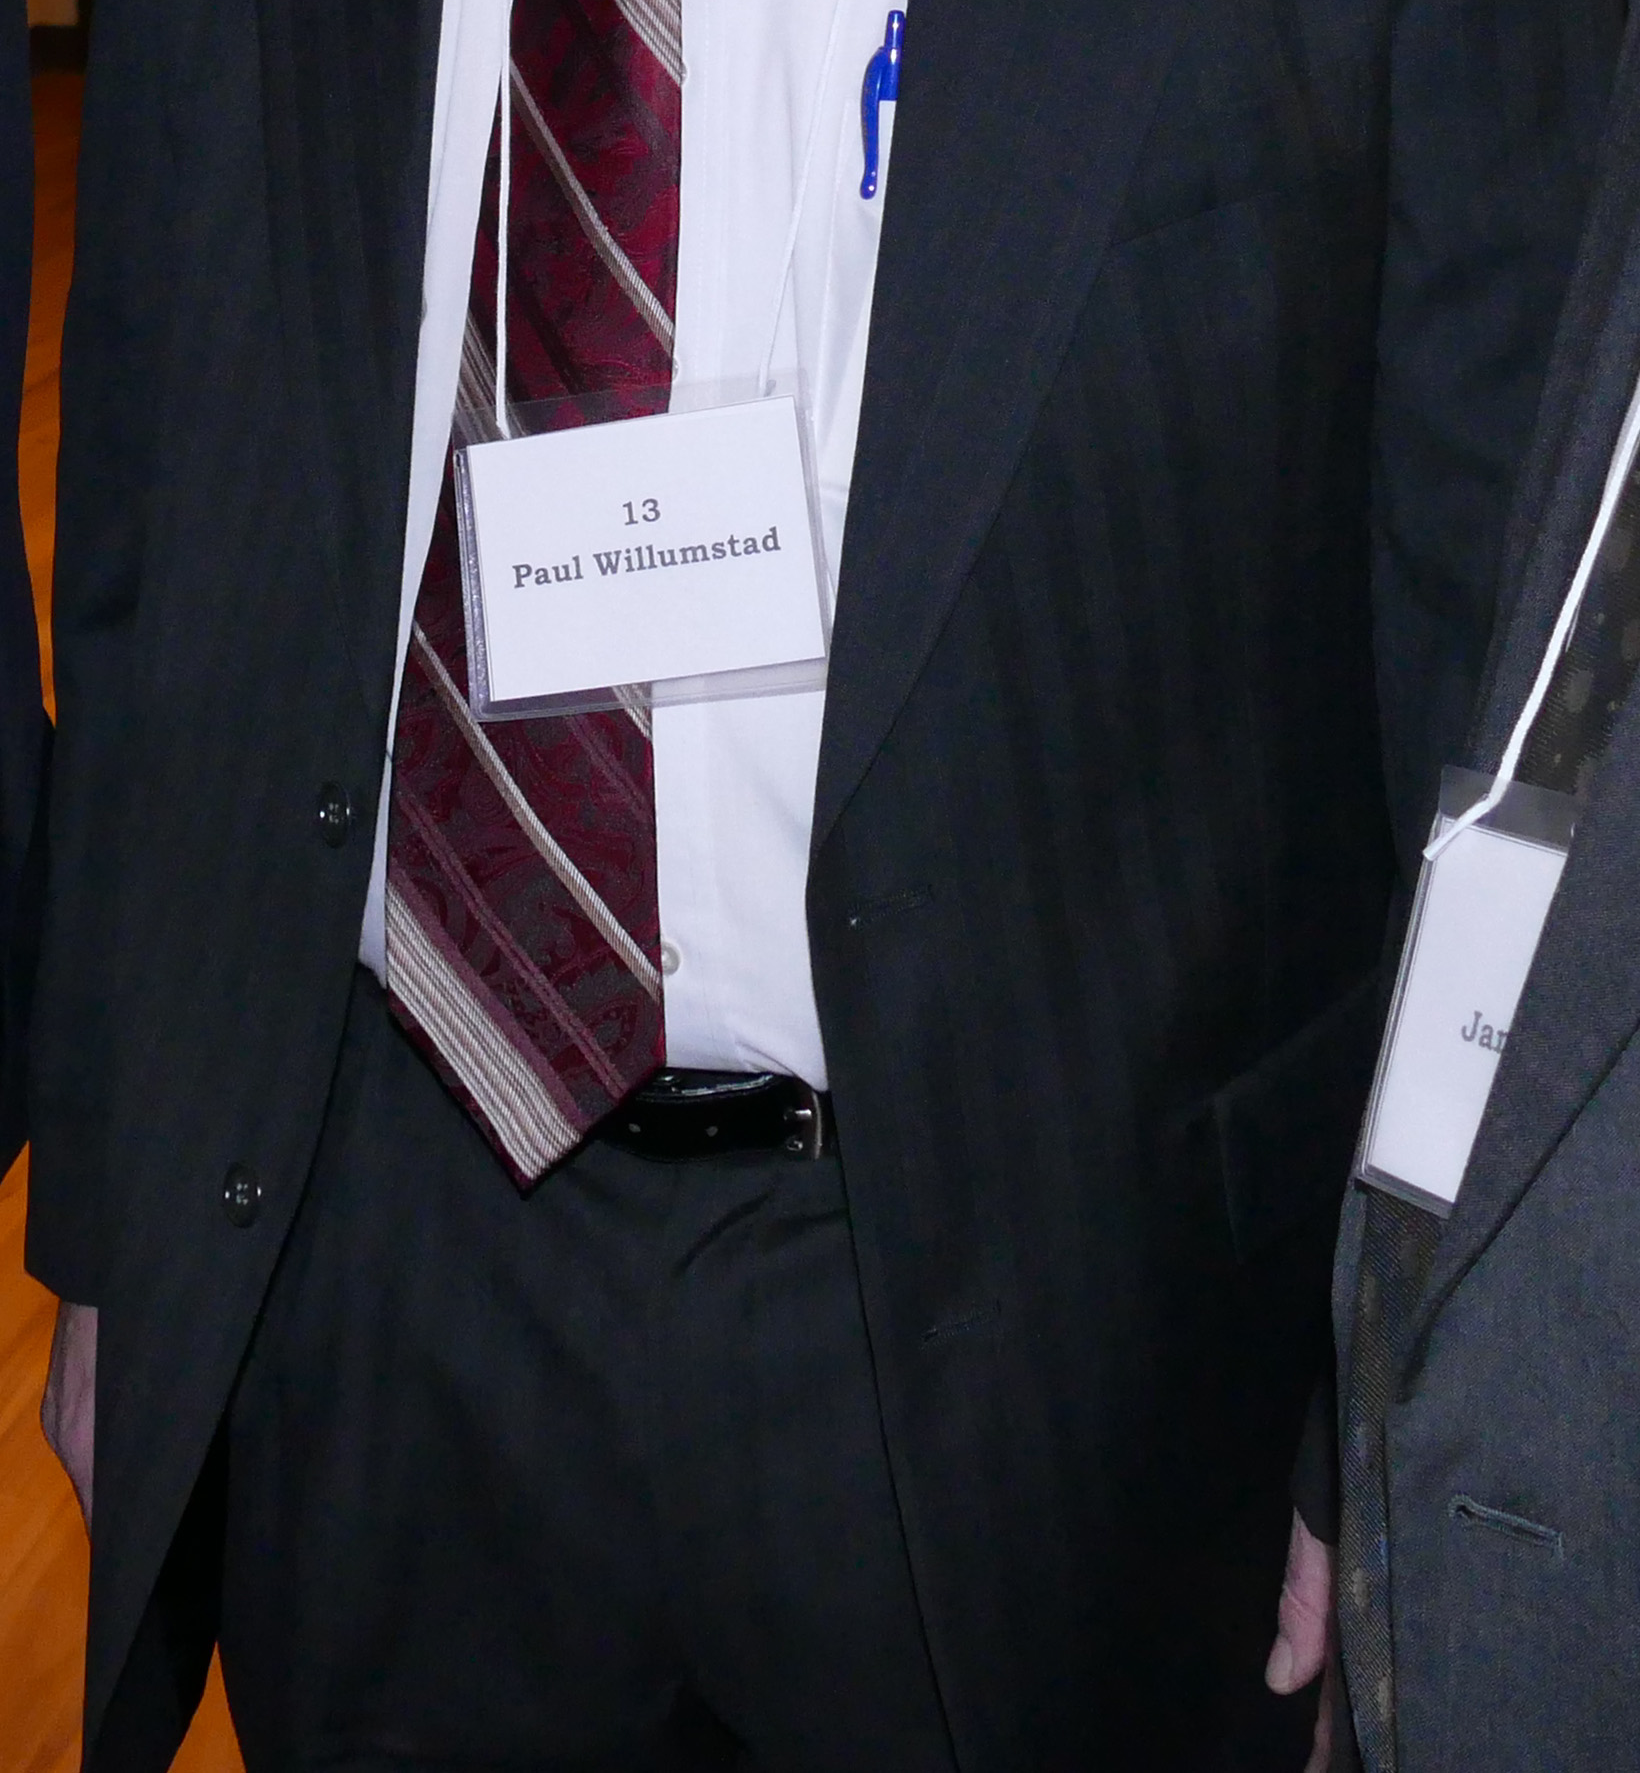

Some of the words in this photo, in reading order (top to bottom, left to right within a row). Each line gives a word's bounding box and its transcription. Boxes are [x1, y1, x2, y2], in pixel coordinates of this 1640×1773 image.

[622, 498, 662, 526] 13
[512, 556, 584, 589] Paul
[593, 526, 782, 577] Willumstad
